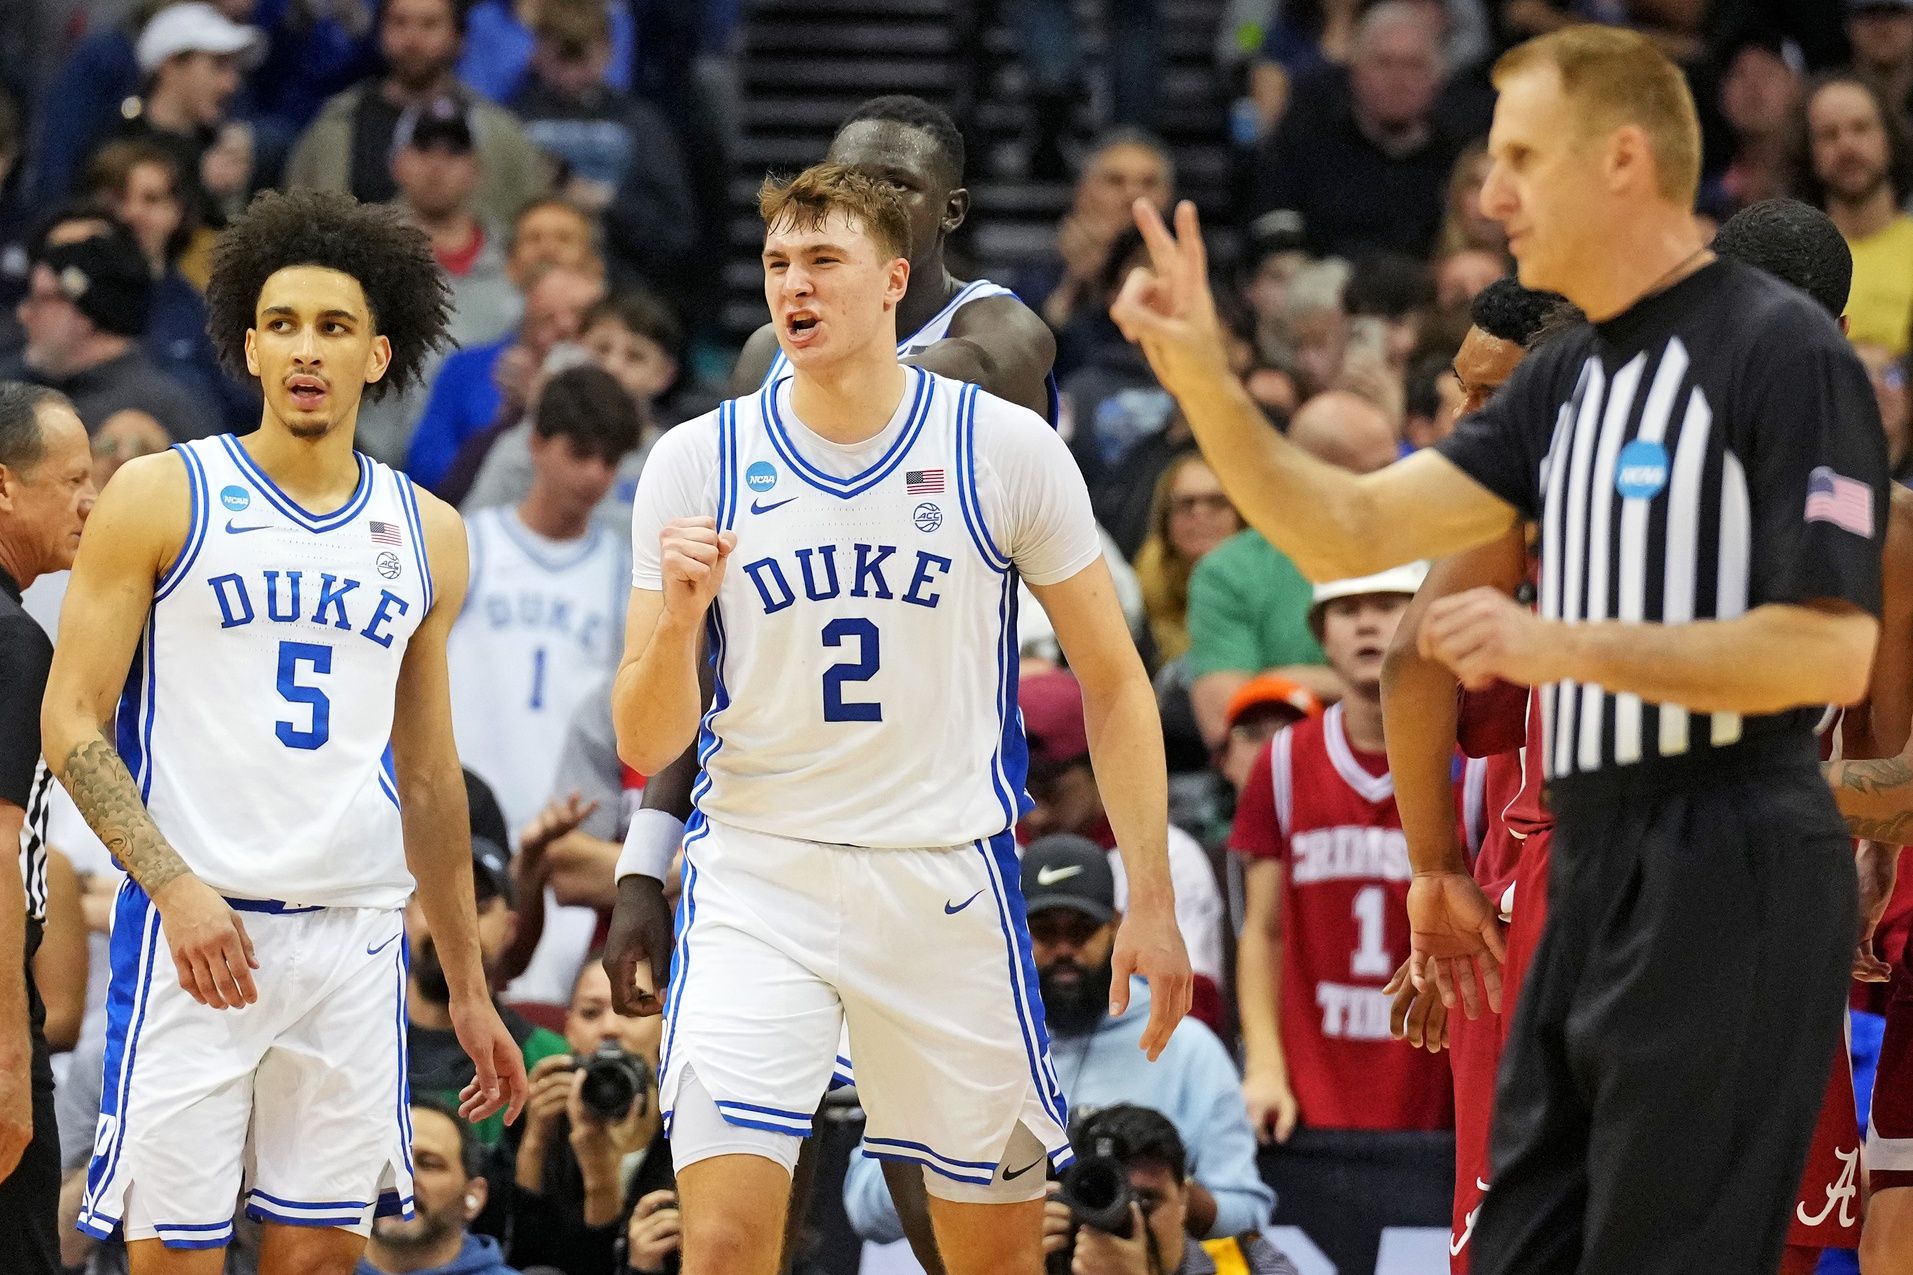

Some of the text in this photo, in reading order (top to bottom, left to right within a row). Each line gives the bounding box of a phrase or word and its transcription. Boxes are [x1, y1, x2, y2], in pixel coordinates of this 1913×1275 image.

[224, 495, 249, 506] NCAA
[749, 475, 775, 485] NCAA
[917, 511, 941, 520] ACC
[207, 570, 409, 648] DUKE
[742, 543, 952, 615] DUKE
[275, 640, 333, 750] 5
[528, 645, 548, 711] 1
[821, 617, 883, 722] 2
[1353, 886, 1392, 977] 1
[1315, 980, 1394, 1041] TID
[1796, 1146, 1859, 1228] A
